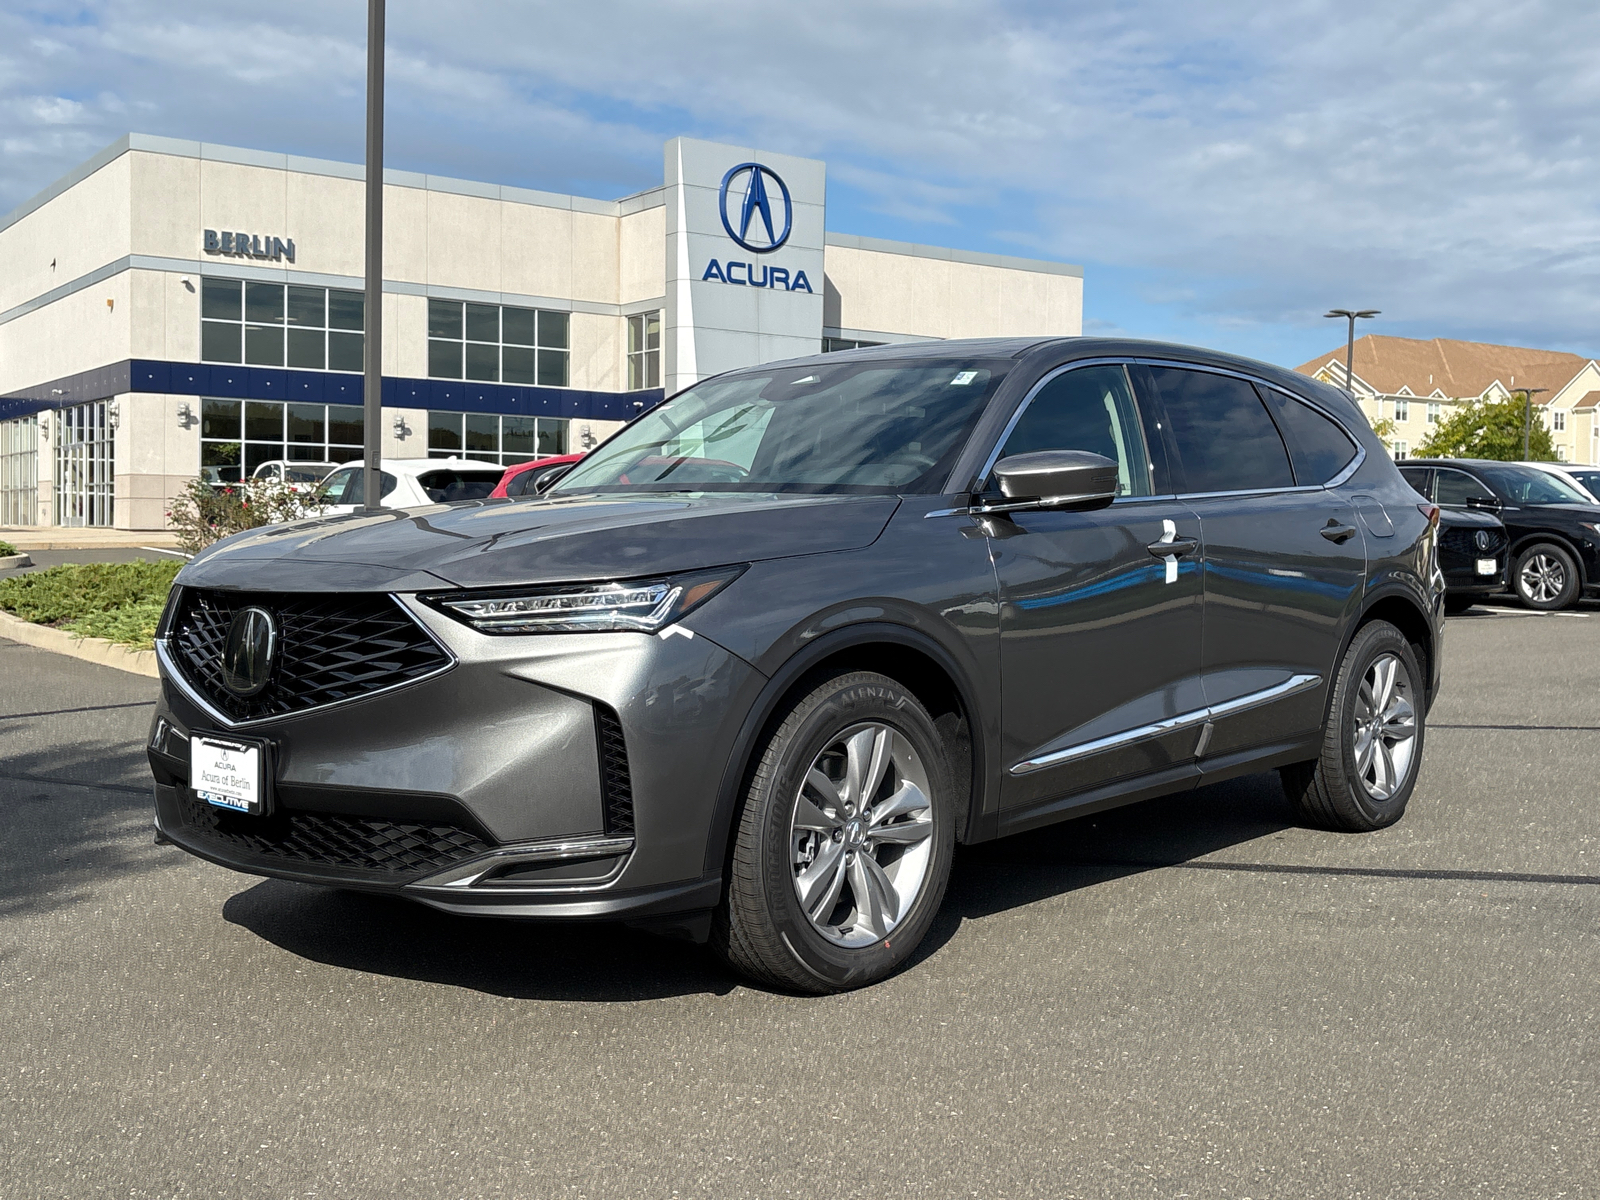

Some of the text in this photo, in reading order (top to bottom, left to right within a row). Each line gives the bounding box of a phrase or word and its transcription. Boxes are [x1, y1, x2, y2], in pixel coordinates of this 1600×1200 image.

[203, 229, 294, 262] BERLIN
[702, 259, 813, 293] ACURA
[841, 687, 895, 702] ALENZA
[214, 761, 236, 772] ACURA
[201, 770, 251, 790] Acura of Berlin
[197, 790, 249, 809] EXECUTIVE
